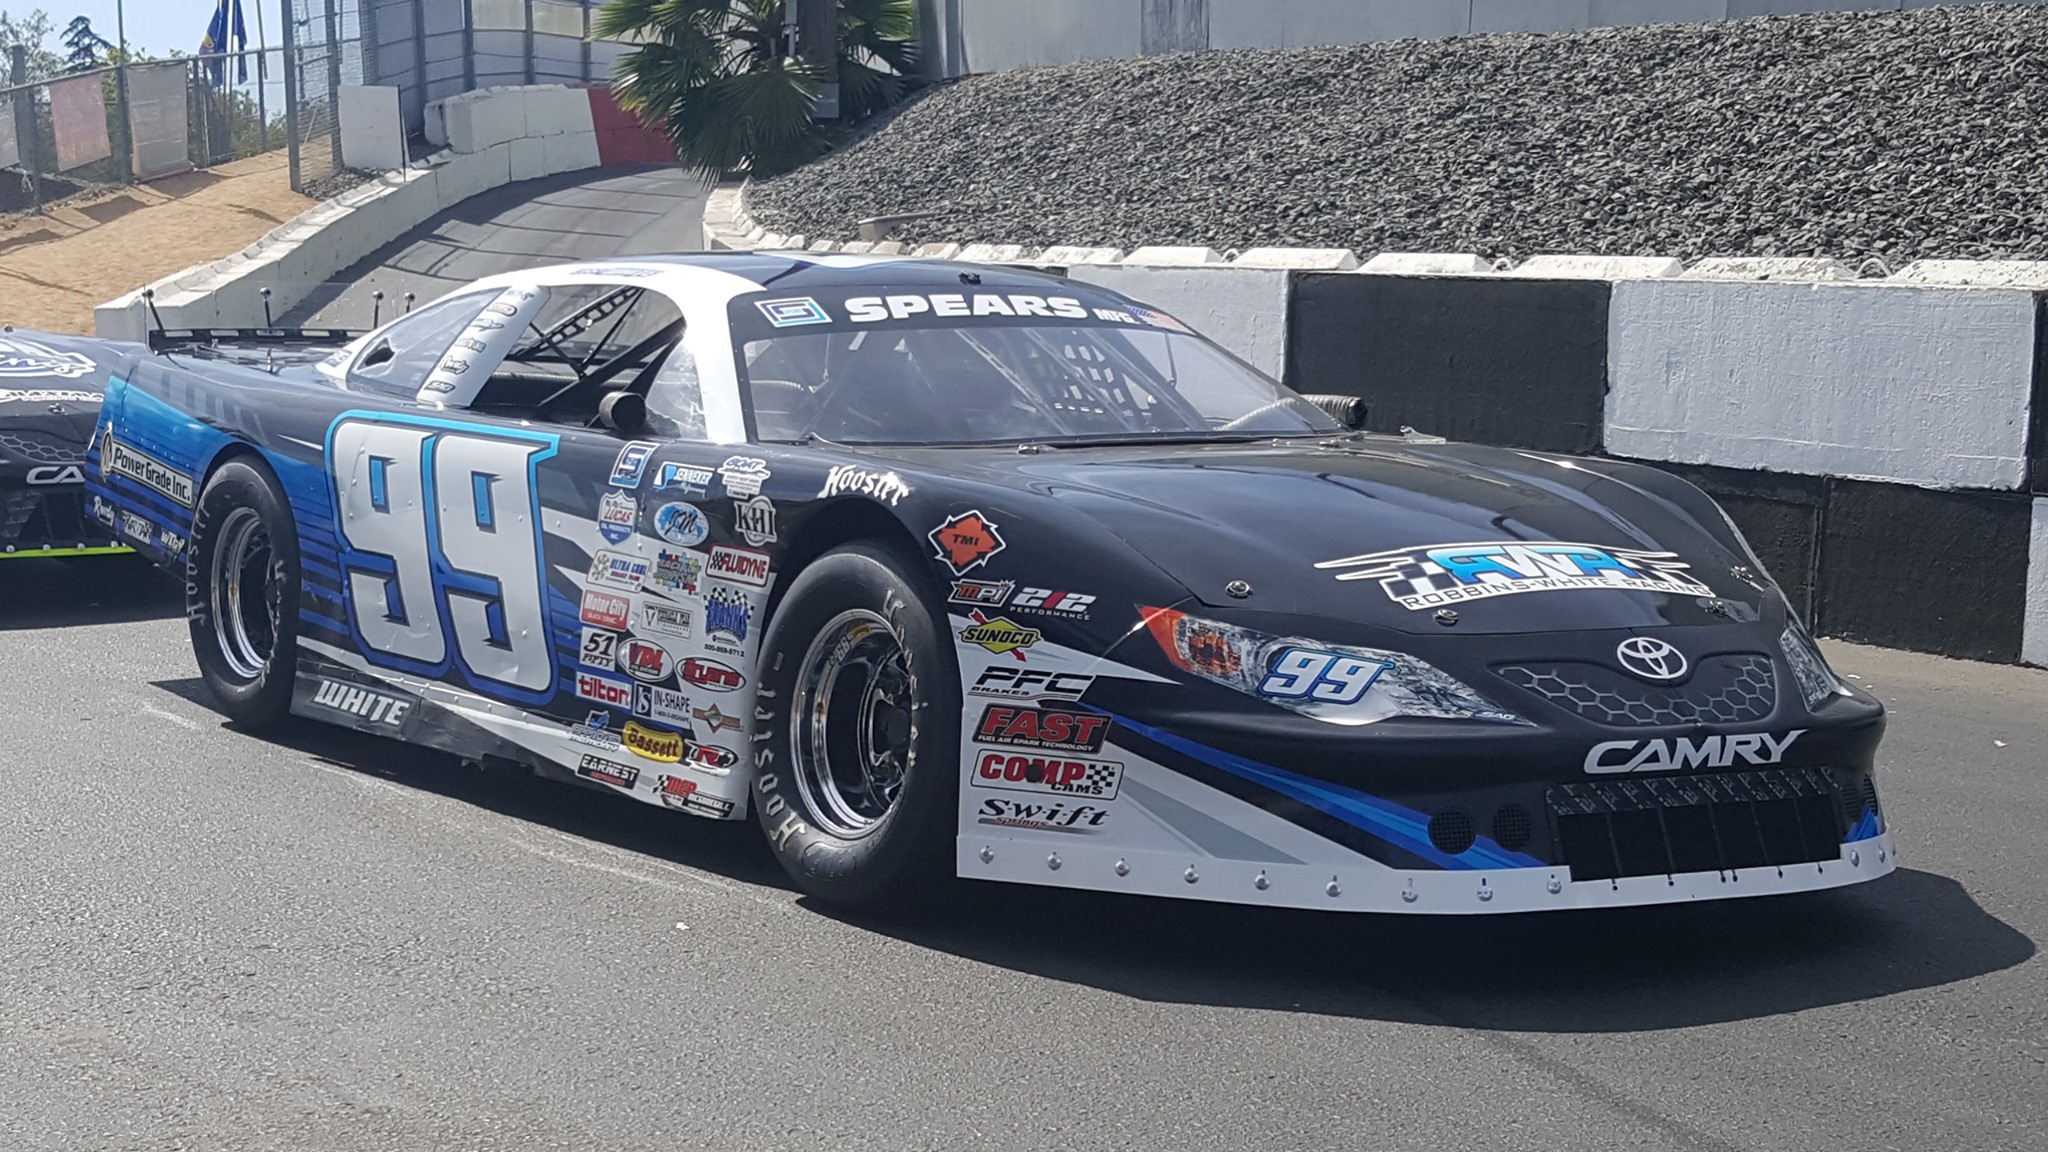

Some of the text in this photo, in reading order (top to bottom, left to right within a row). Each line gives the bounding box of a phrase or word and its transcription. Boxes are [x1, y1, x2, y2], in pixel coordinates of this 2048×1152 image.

[844, 294, 1088, 323] SPEARS
[172, 475, 191, 502] Inc.
[603, 508, 633, 523] LUCAS
[736, 504, 775, 537] KHI
[952, 534, 980, 546] TMI
[327, 413, 556, 698] 99
[720, 552, 767, 579] FLUIDYNE
[1011, 587, 1097, 612] 212
[1402, 577, 1713, 608] ROBBINS-WHITE RACING
[584, 593, 628, 621] Motor City
[1009, 606, 1090, 620] PERFORMANCE
[583, 632, 616, 657] 51
[964, 628, 1035, 645] SUNOCO
[582, 653, 614, 667] FIFTY
[976, 666, 1094, 694] PFC
[1259, 649, 1388, 703] 99
[313, 679, 410, 726] WHITE
[578, 675, 630, 706] tilton
[654, 690, 690, 714] IN-SHAPE
[970, 686, 1030, 696] BRAKES
[981, 708, 1102, 744] FAST
[628, 728, 679, 758] Bassett
[978, 734, 996, 743] FUEL
[1013, 738, 1041, 748] SPARK
[1041, 740, 1094, 752] TECHNOLOGY
[1583, 729, 1808, 774] CAMRY
[581, 756, 638, 781] EARNEST
[749, 681, 807, 852] Hoosier
[980, 754, 1086, 785] COMP
[1051, 782, 1103, 795] CAMS
